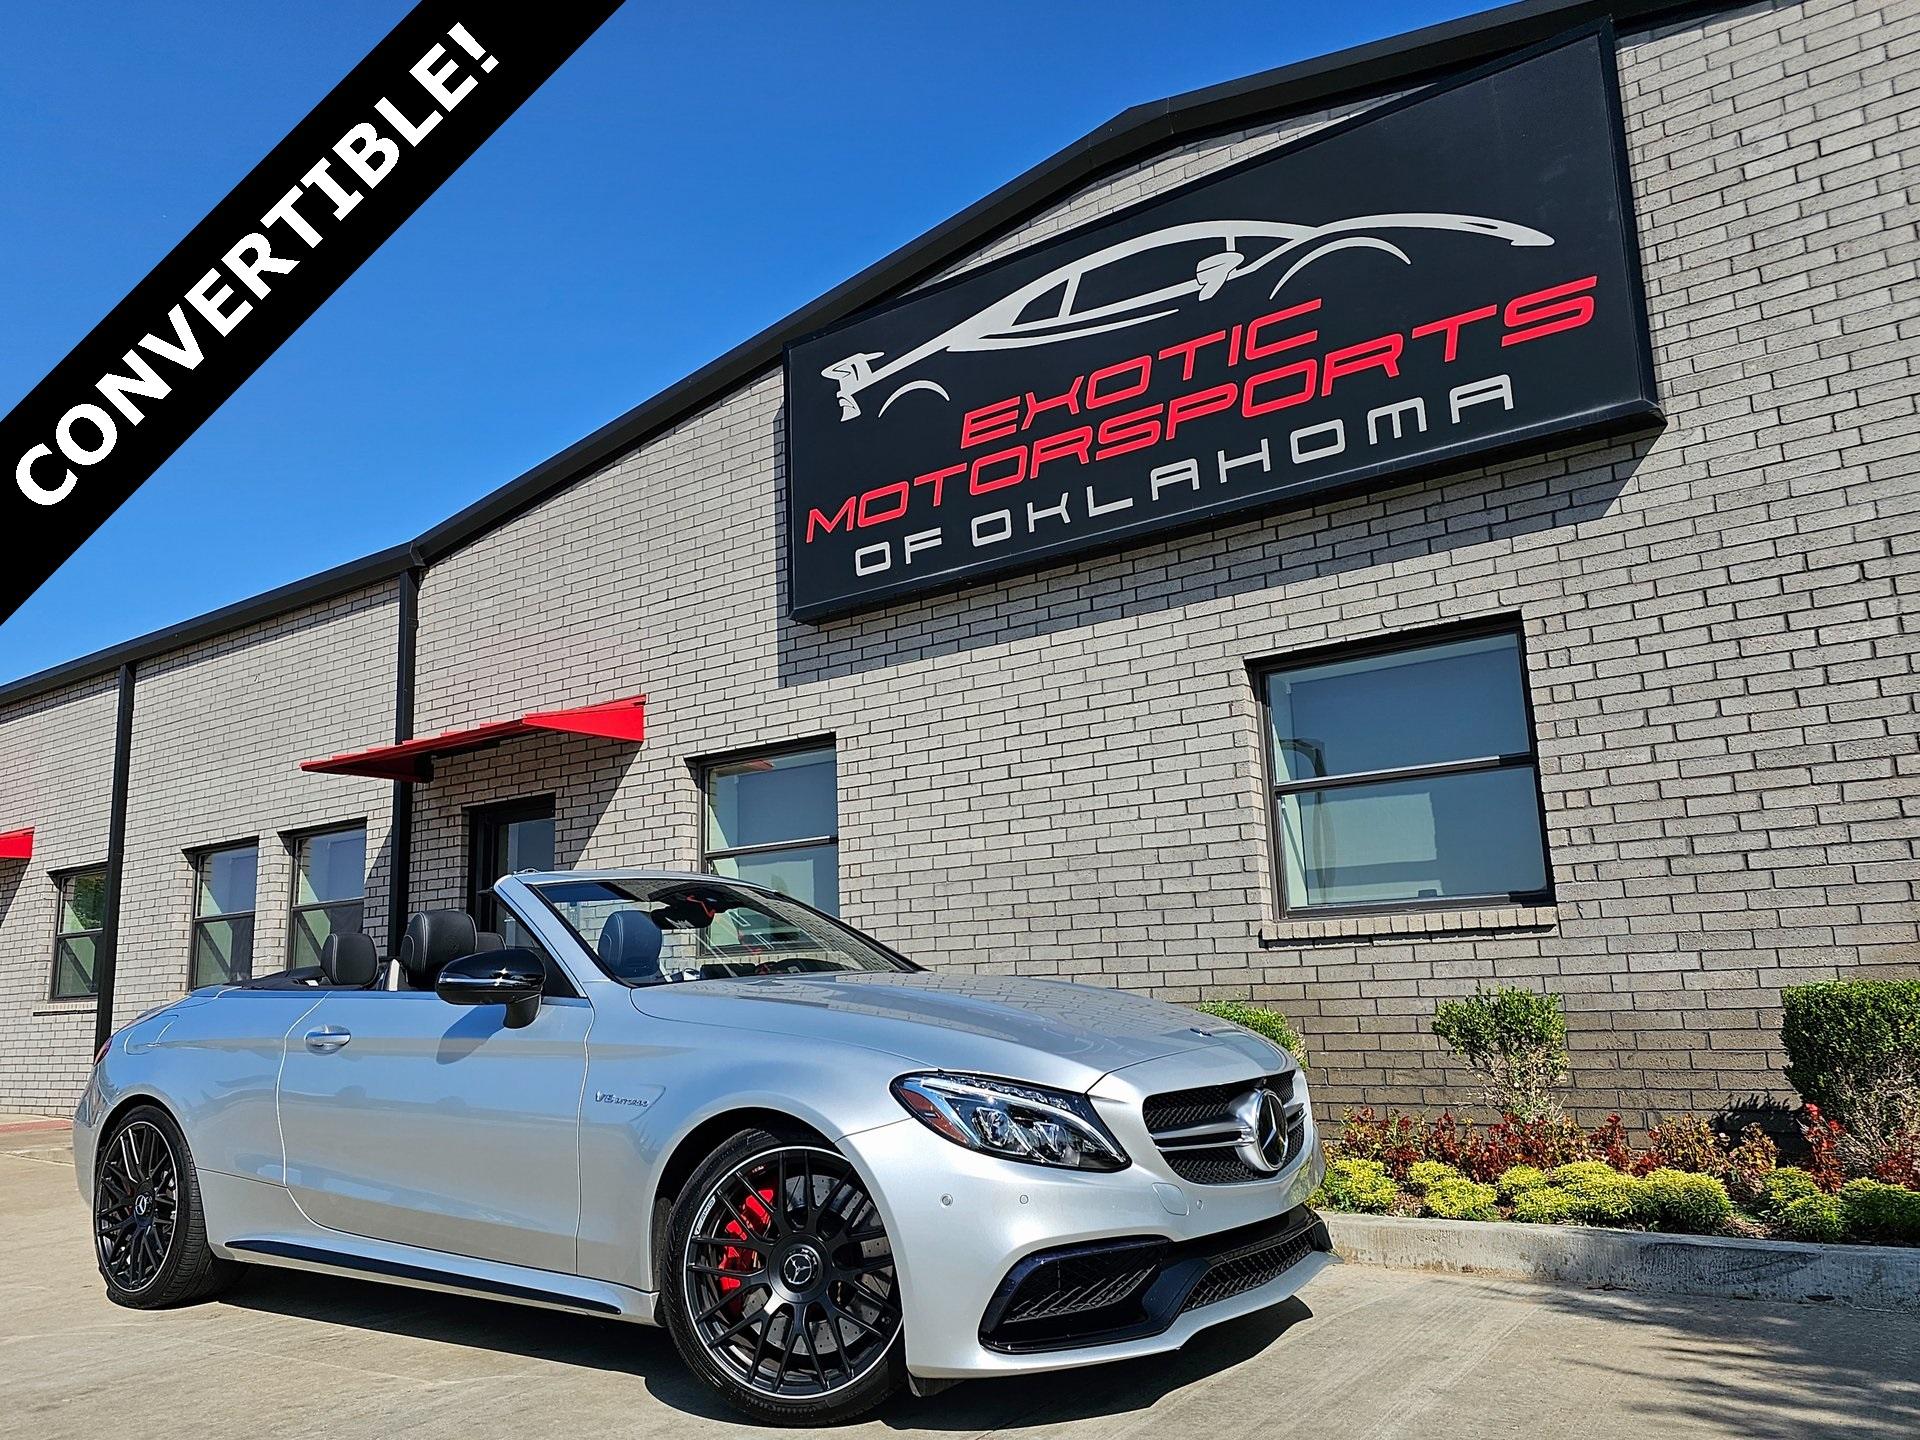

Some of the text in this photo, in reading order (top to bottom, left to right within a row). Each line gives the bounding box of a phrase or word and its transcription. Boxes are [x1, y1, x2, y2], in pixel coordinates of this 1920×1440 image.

[805, 275, 1598, 544] MOTORSPORTS
[854, 373, 1516, 578] OF OKLAHOMA
[960, 297, 1323, 450] EXOTIC
